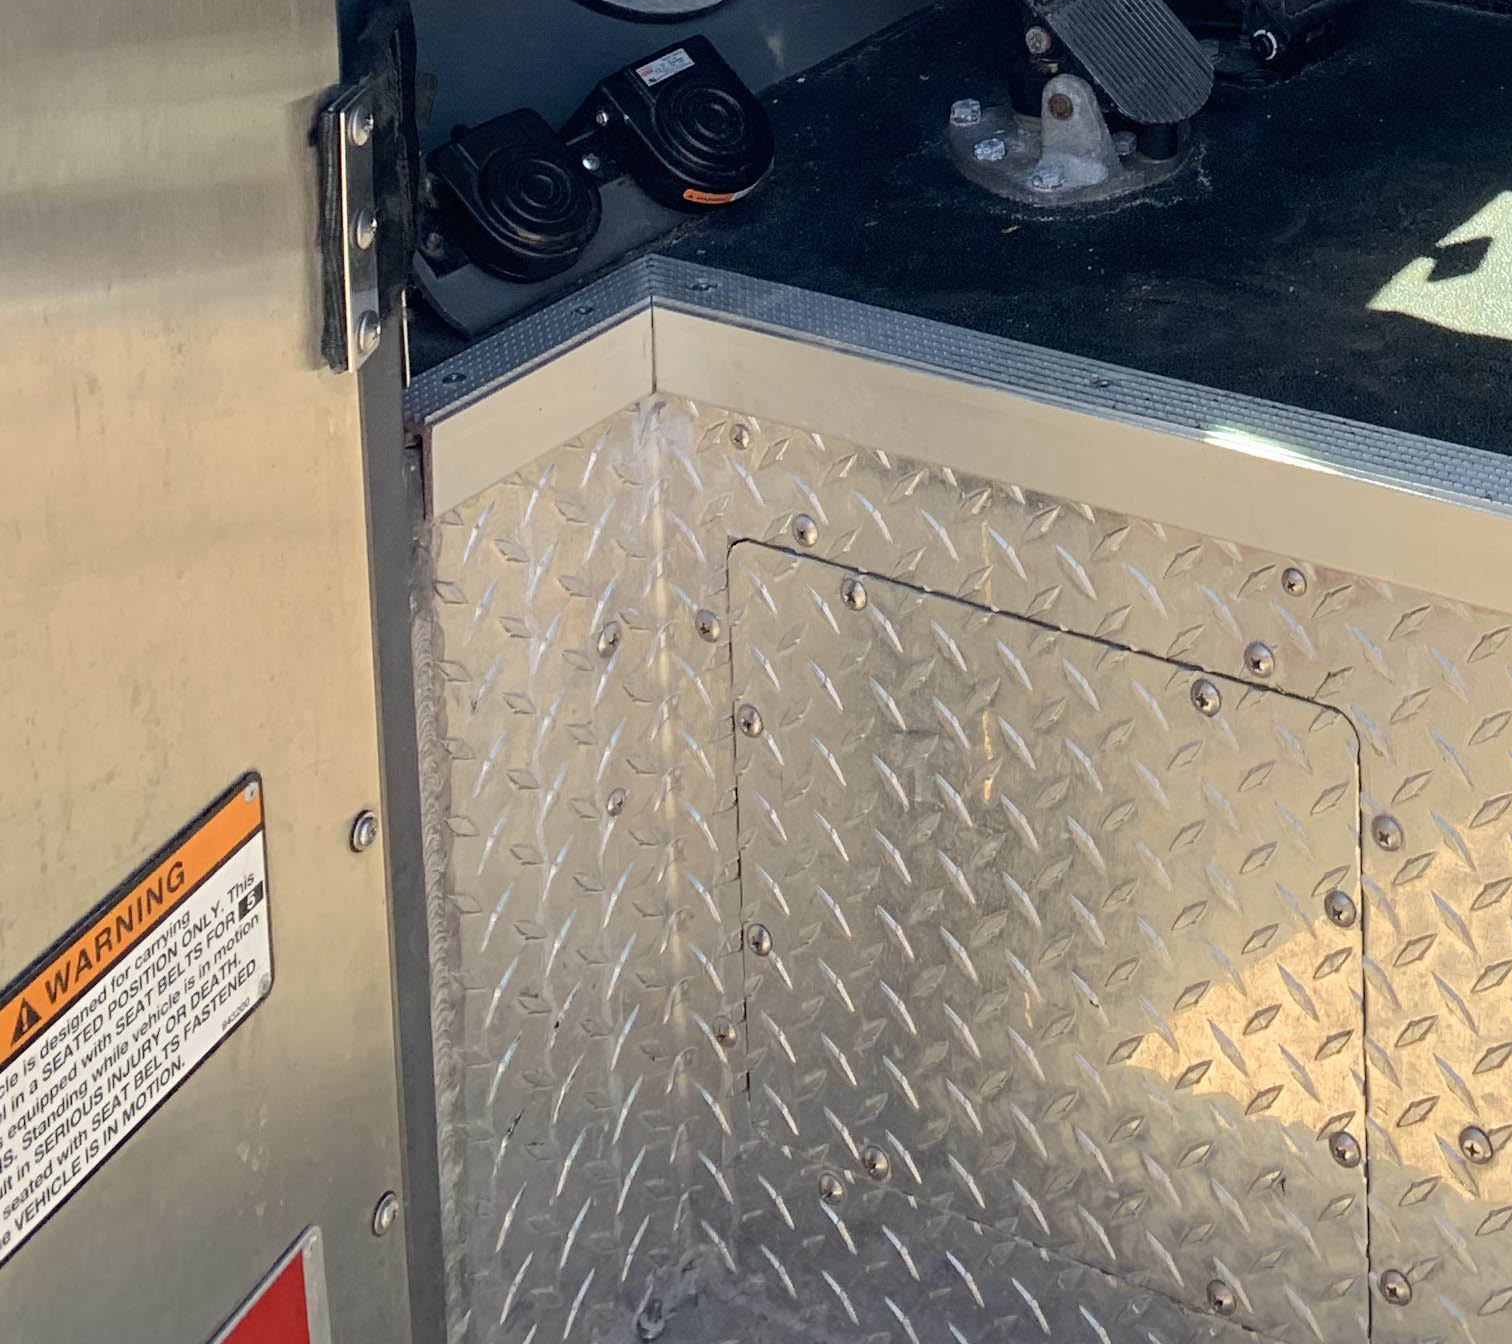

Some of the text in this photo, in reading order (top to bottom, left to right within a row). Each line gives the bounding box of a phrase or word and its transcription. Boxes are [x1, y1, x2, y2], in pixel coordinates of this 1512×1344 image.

[8, 1067, 77, 1140] equipped
[81, 1033, 111, 1068] with
[115, 989, 154, 1036] SEAT
[158, 942, 203, 996] BELTS
[206, 911, 235, 948] FOR
[246, 891, 256, 910] 5
[11, 873, 255, 1112] in a SEATED POSITION ONLY. This
[22, 1081, 88, 1150] Standing
[91, 1040, 129, 1082] while
[132, 990, 180, 1042] vehicle
[184, 974, 195, 994] is
[199, 960, 211, 979] in
[214, 914, 259, 963] motion
[23, 1059, 36, 1076] is
[40, 987, 107, 1060] designed
[111, 965, 131, 994] for
[134, 910, 190, 969] carrying
[44, 861, 185, 1005] WARNING
[3, 1159, 53, 1220] seated
[57, 1129, 88, 1166] with
[91, 1083, 131, 1132] SEAT
[134, 1034, 180, 1091] BELTS
[183, 959, 256, 1041] FASTENED
[15, 1156, 81, 1231] VEHICLE
[85, 1139, 99, 1164] IS
[103, 1119, 118, 1145] IN
[122, 1055, 185, 1127] MOTION.
[17, 1161, 30, 1181] in
[34, 1086, 103, 1163] SERIOUS
[107, 1027, 161, 1092] INJURY
[165, 1004, 186, 1034] OR
[190, 952, 242, 1010] DEATH.
